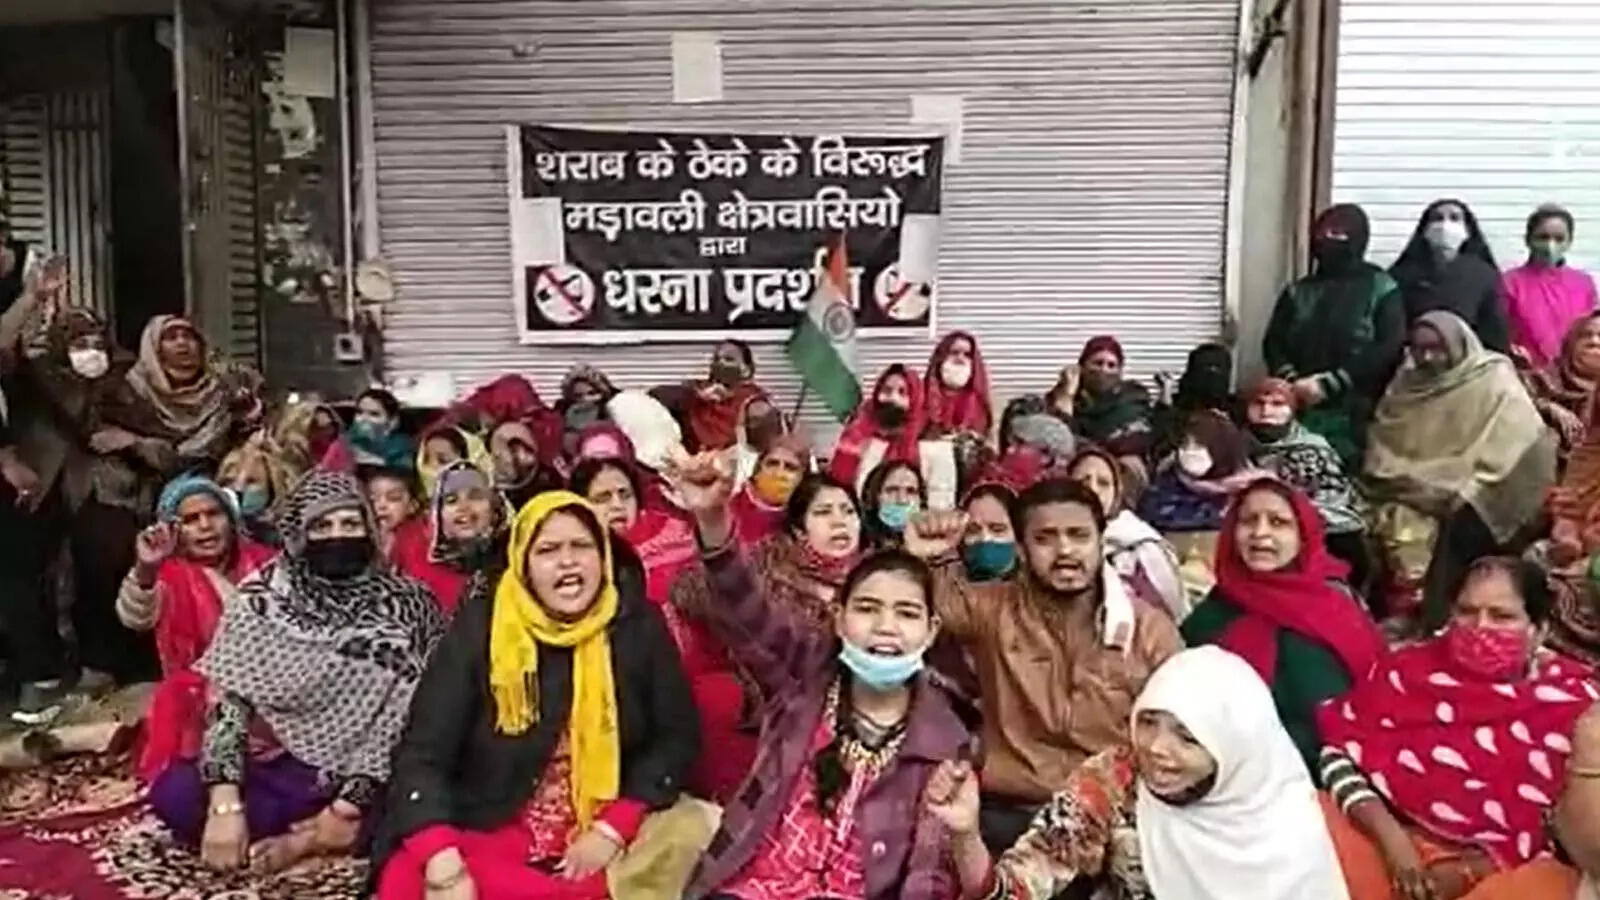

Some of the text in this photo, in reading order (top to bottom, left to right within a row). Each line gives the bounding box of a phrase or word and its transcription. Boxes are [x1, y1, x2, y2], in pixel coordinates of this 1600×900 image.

[535, 151, 627, 180] शराब
[636, 138, 678, 180] के
[686, 138, 751, 179] ठेके
[759, 138, 801, 178] के
[603, 267, 713, 313] धरना
